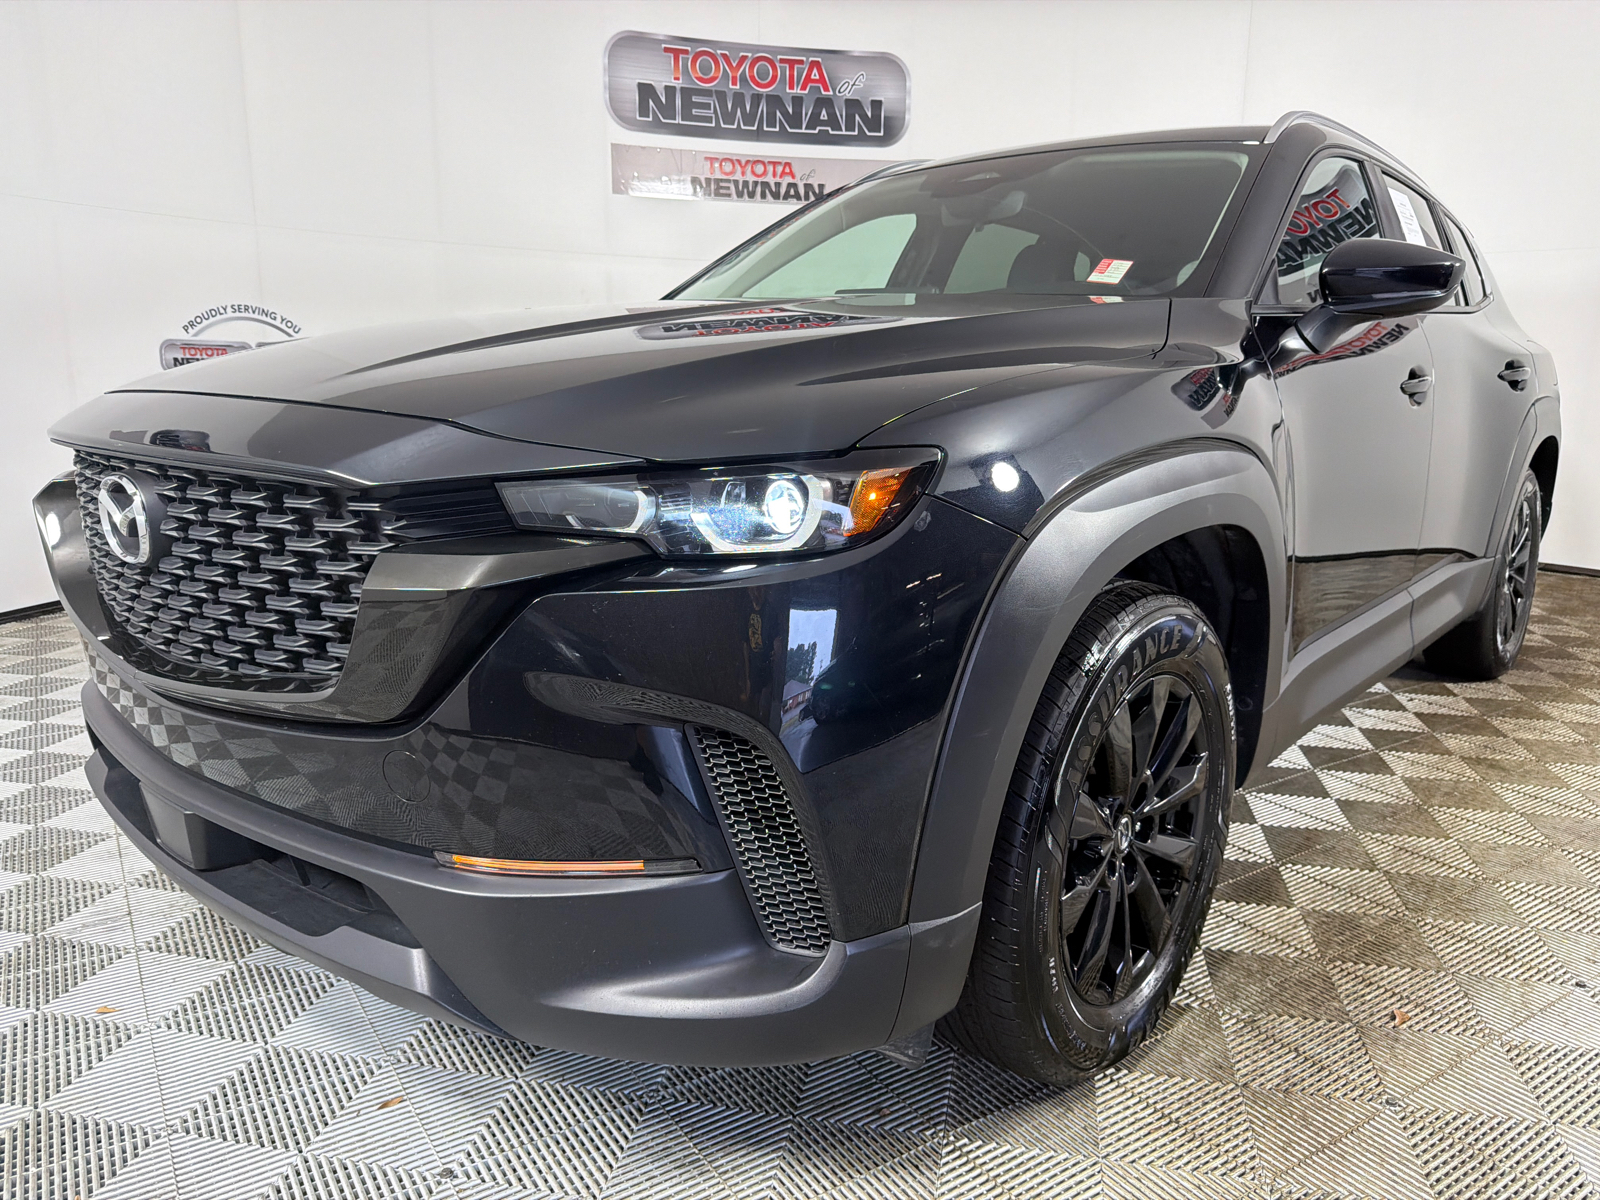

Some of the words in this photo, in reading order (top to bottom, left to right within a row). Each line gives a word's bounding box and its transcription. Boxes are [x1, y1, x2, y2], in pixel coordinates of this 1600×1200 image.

[662, 45, 831, 94] TOYOTA
[836, 72, 866, 96] of
[636, 82, 884, 136] NEWNAN
[704, 156, 796, 180] TOYOTA
[800, 169, 816, 181] of
[690, 176, 825, 201] NEWNAN
[182, 305, 229, 334] PROUDLY
[230, 304, 277, 322] SERVING
[280, 315, 302, 335] YOU
